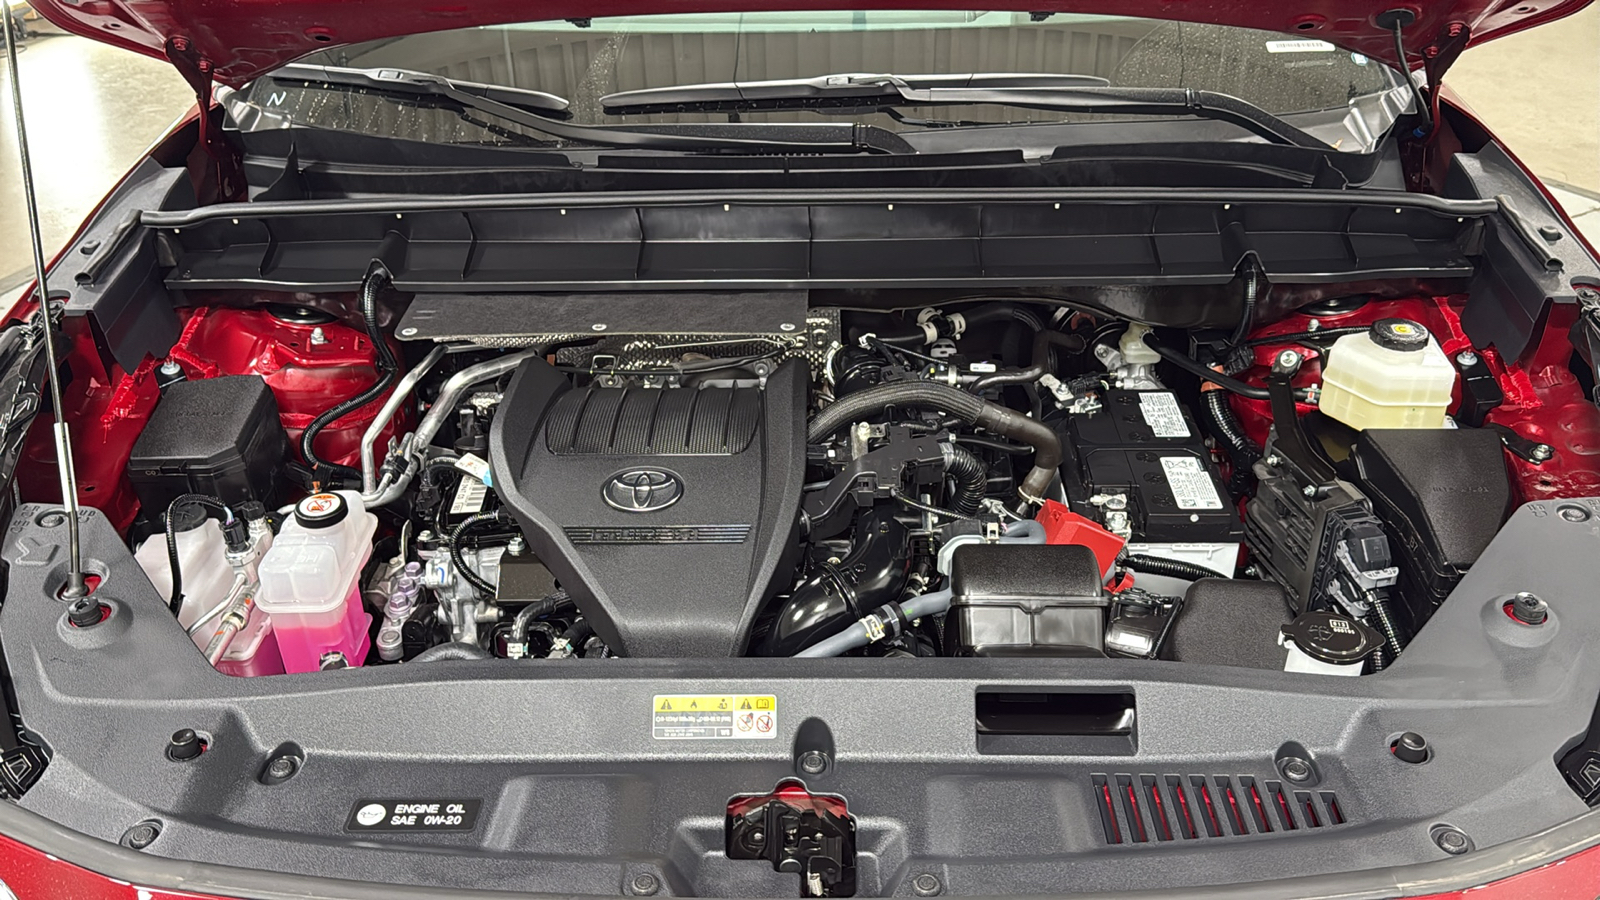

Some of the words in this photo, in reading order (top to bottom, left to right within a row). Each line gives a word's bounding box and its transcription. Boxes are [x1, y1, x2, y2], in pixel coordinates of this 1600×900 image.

[394, 804, 441, 814] ENGINE
[446, 804, 466, 814] OIL
[390, 815, 417, 825] SAE
[423, 815, 462, 825] 0W-20
